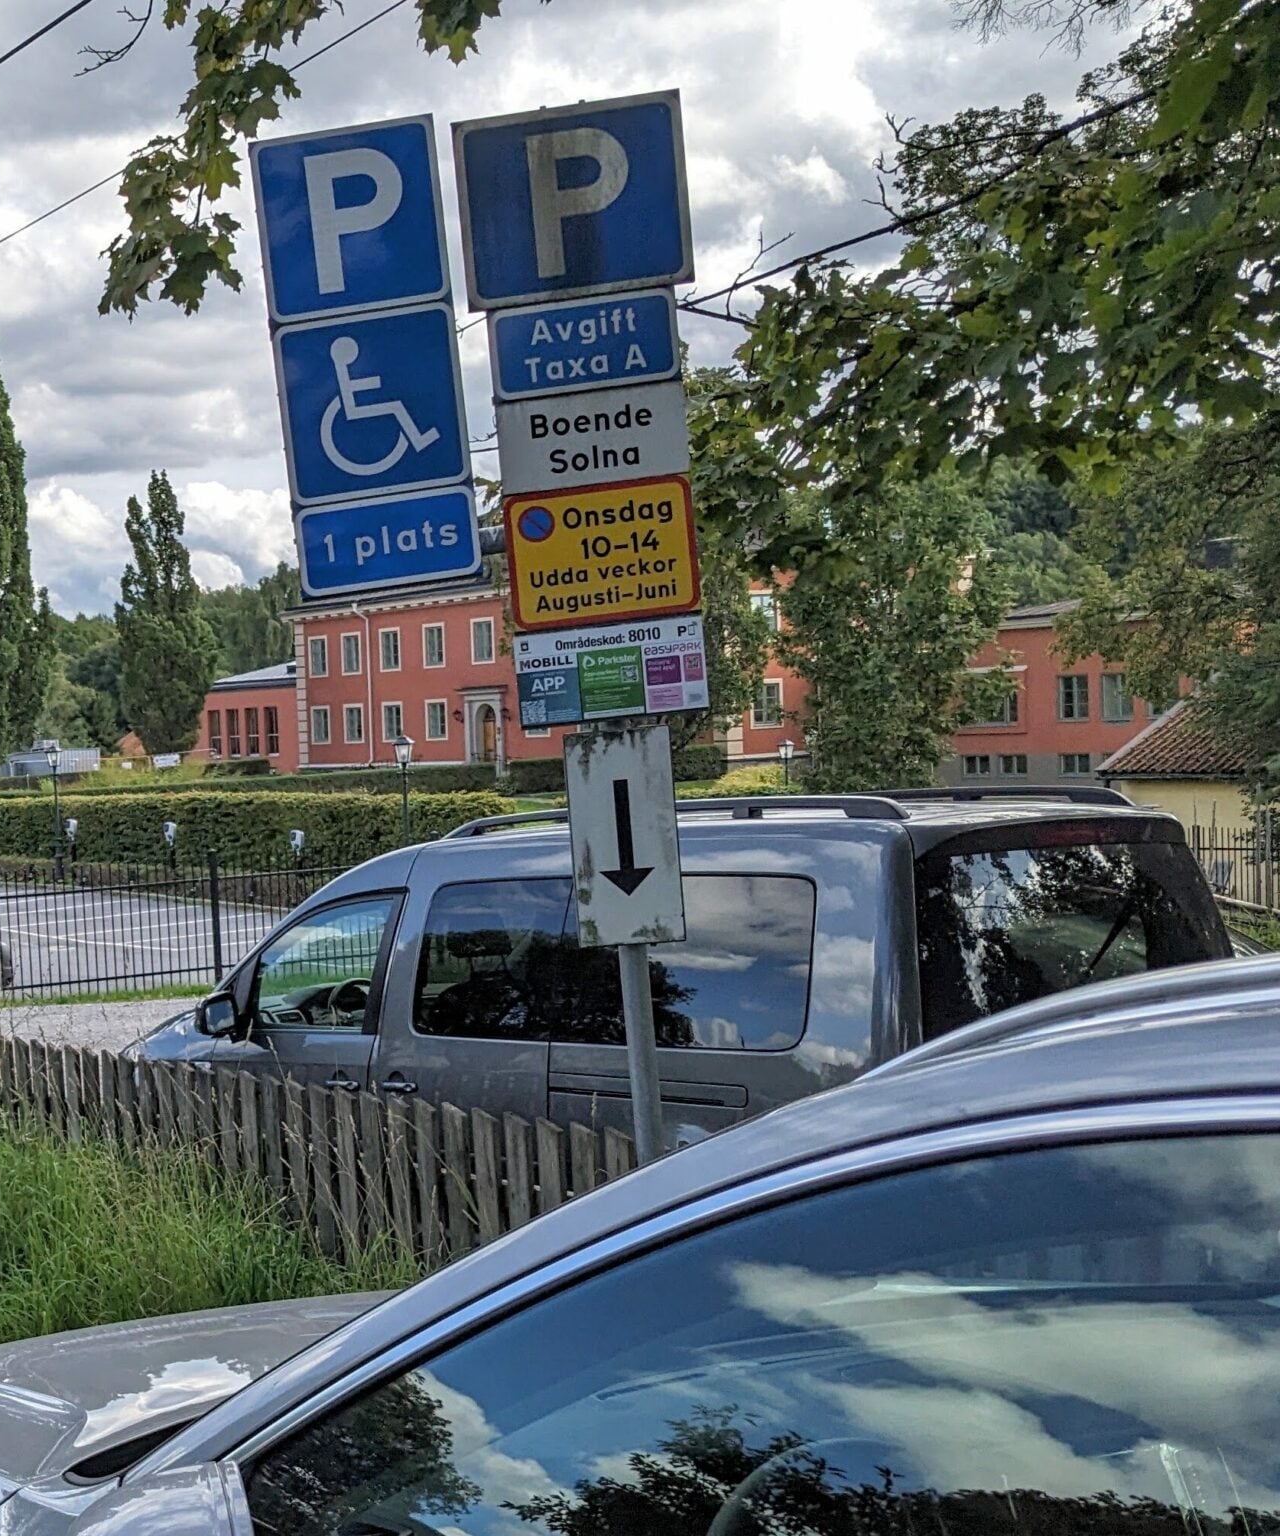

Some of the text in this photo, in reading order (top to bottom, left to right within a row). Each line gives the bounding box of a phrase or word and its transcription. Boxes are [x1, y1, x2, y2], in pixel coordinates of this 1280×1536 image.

[525, 126, 629, 280] P
[303, 147, 403, 295] P
[530, 307, 637, 346] Avgift
[524, 343, 648, 383] Taxa A
[530, 404, 653, 439] Boende
[549, 445, 640, 474] Solna
[562, 499, 673, 529] Onsdag
[323, 520, 458, 566] 1 plats
[580, 529, 660, 560] 10-14
[529, 557, 678, 589] Udda veckor
[535, 579, 678, 613] Augusti-Juni
[555, 627, 661, 651] Områdeskod: 8010
[519, 655, 573, 672] MOBILL
[531, 676, 566, 692] APP
